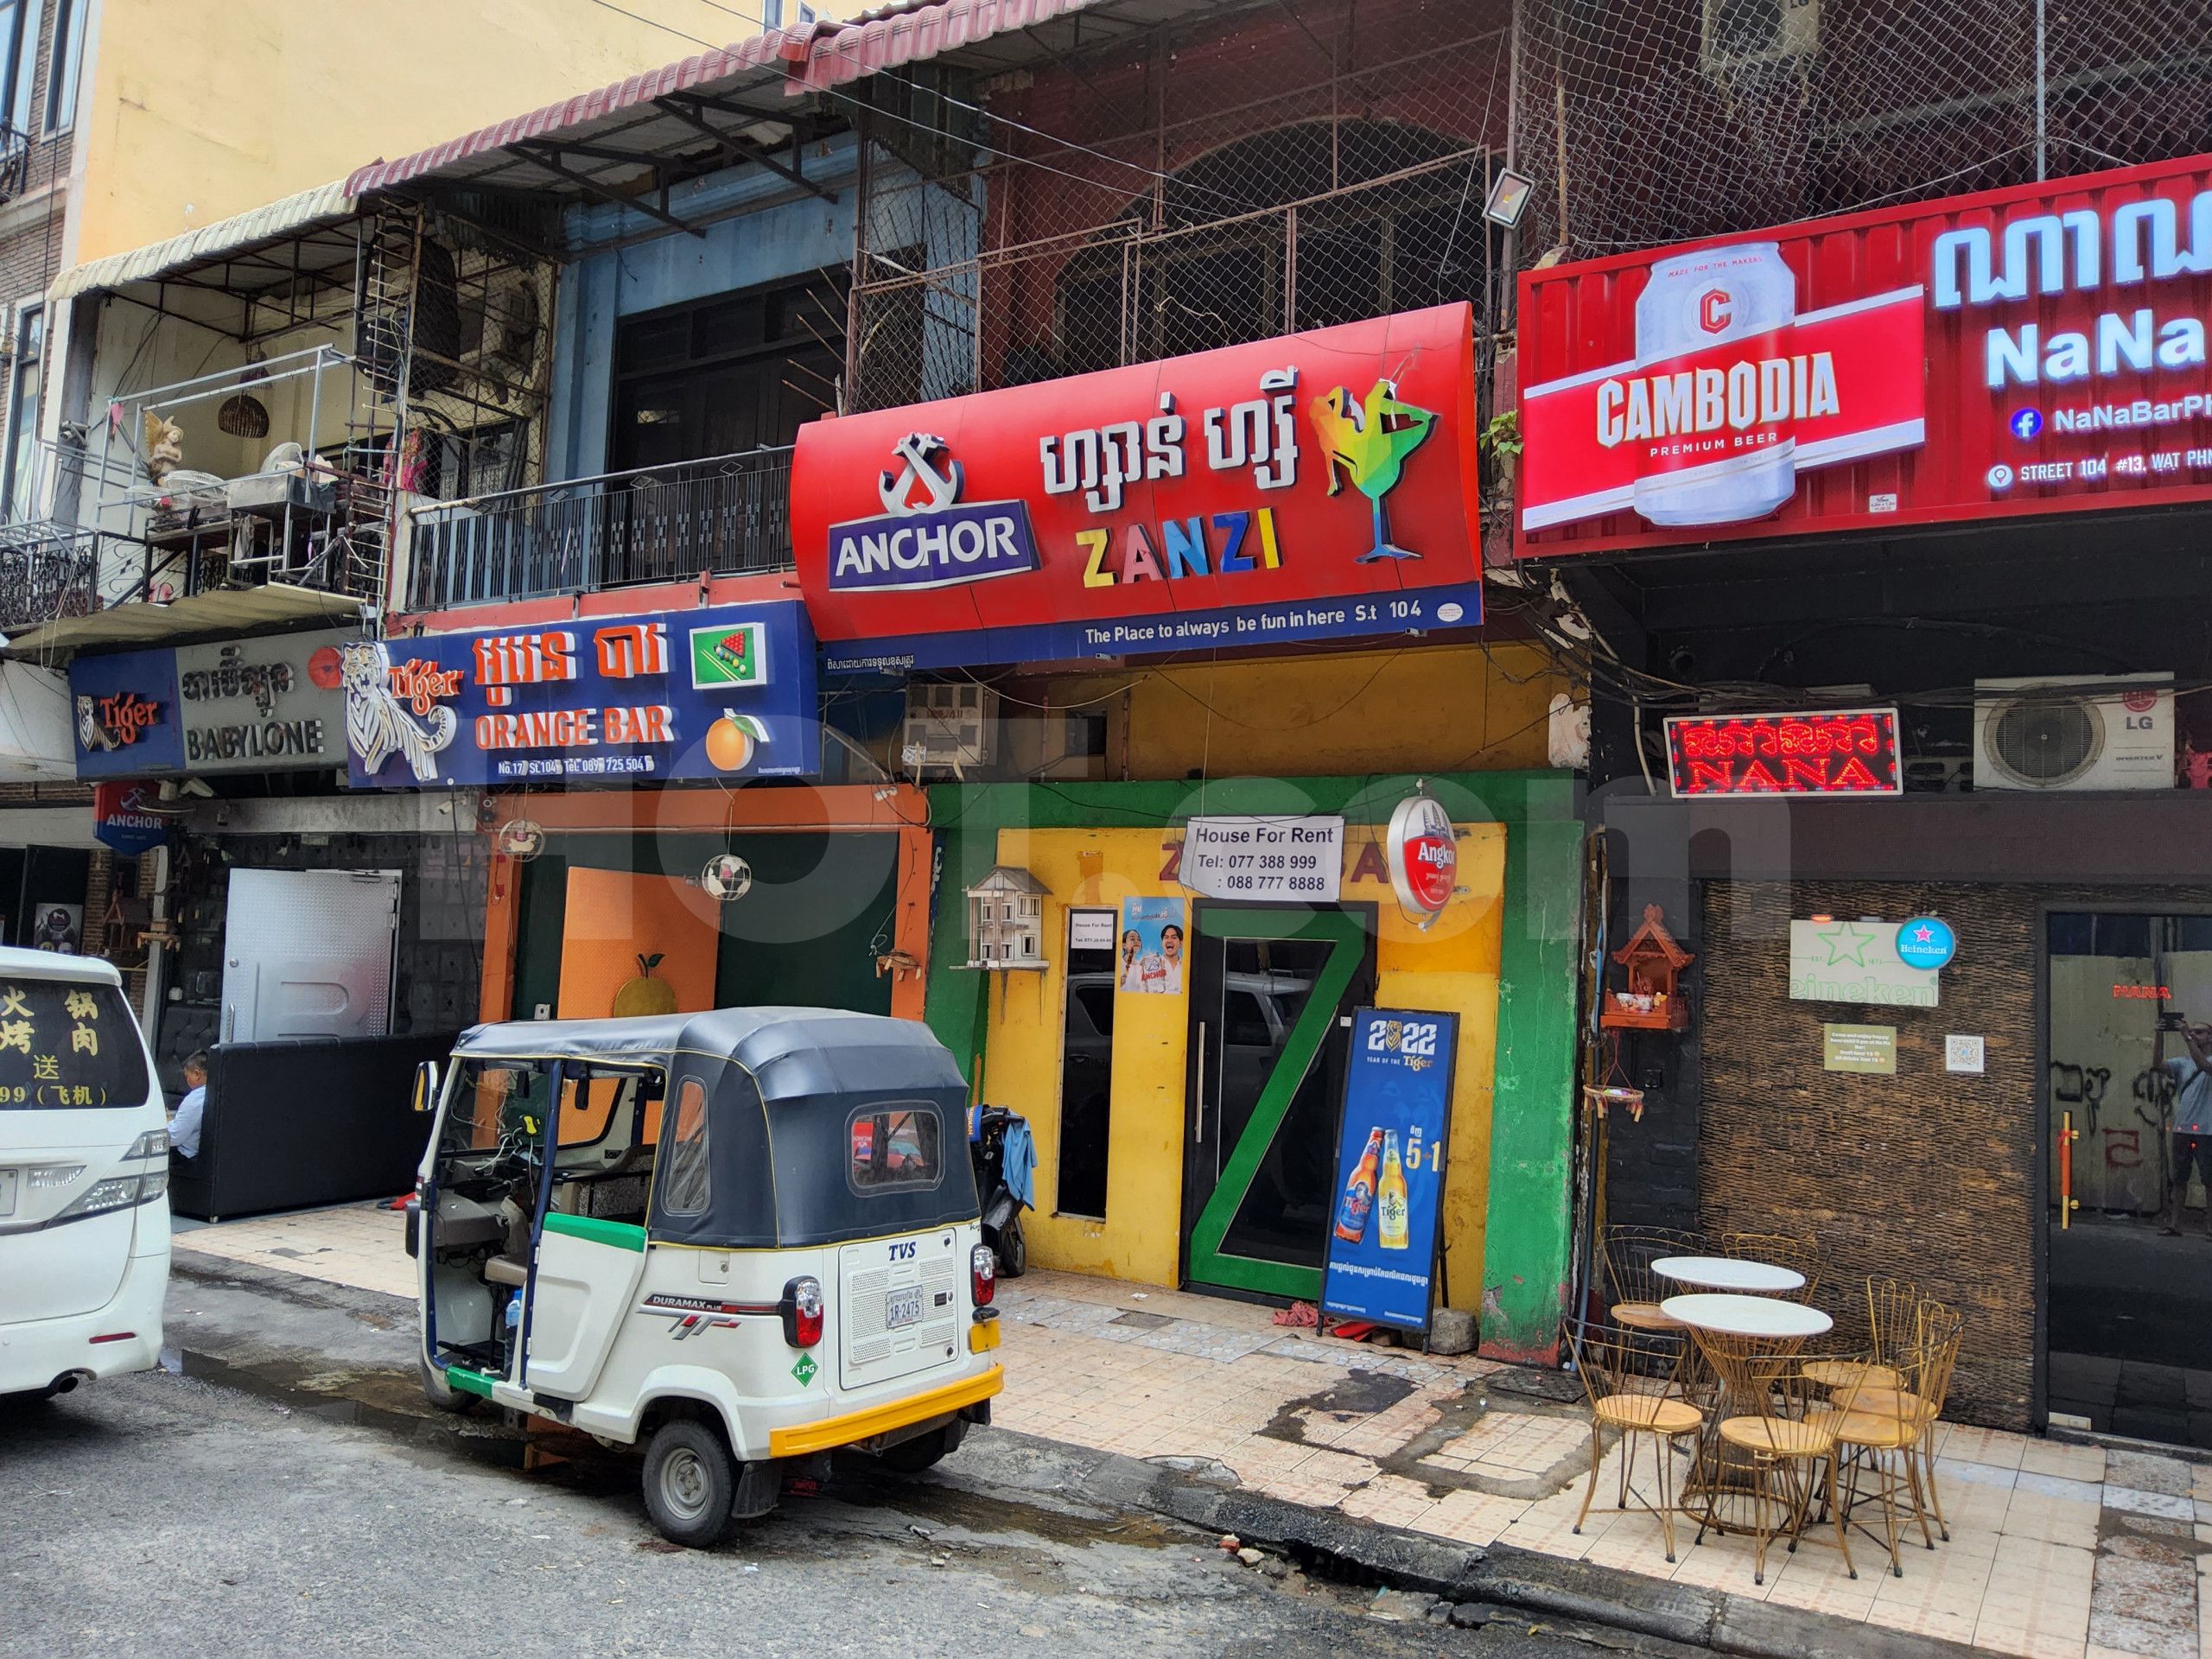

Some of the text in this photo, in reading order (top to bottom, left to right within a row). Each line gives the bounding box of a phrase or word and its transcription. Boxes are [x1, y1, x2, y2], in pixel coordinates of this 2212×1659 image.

[1668, 270, 1688, 278] MADE
[1988, 308, 2205, 385] NaNa
[1597, 351, 1840, 448] CAMBODIA
[1650, 432, 1777, 457] PREMIUM BEER
[2021, 462, 2073, 480] STREET
[2081, 459, 2107, 475] 104
[2152, 452, 2181, 469] WAT
[836, 516, 1020, 577] ANCHOR
[1076, 507, 1283, 588] ZANZI
[1085, 628, 1111, 644] The
[1115, 626, 1154, 641] Place
[1159, 624, 1173, 639] to
[1175, 620, 1230, 639] always
[1237, 615, 1255, 632] be
[1261, 613, 1287, 630] fun
[1290, 612, 1304, 627] in
[1306, 609, 1345, 626] here
[1355, 605, 1377, 622] S.t
[1389, 600, 1422, 619] 104
[388, 658, 463, 715] Tiger
[99, 692, 157, 744] Tiger
[475, 705, 674, 750] ORANGE BAR
[2126, 715, 2153, 730] LG
[187, 720, 323, 761] BABYLONE
[499, 760, 524, 775] No.17
[529, 760, 557, 774] St.104
[582, 758, 600, 772] 089
[606, 758, 624, 771] 725
[626, 756, 644, 771] 504
[1688, 757, 1880, 788] NANA
[106, 814, 162, 830] ANCHOR
[1196, 827, 1333, 843] House For Rent
[1198, 855, 1317, 868] Tel: 077 388 999
[1227, 876, 1252, 889] 088
[1258, 876, 1284, 889] 777
[1288, 876, 1325, 890] 8888
[1901, 944, 1947, 955] Heineken
[33, 1054, 60, 1079] 送
[1403, 1055, 1433, 1071] Tiger
[1344, 1196, 1370, 1216] Tiger
[1381, 1205, 1405, 1221] Tiger
[888, 1241, 917, 1262] TVS
[652, 1296, 707, 1309] DURAMAX
[797, 1363, 815, 1375] LPG
